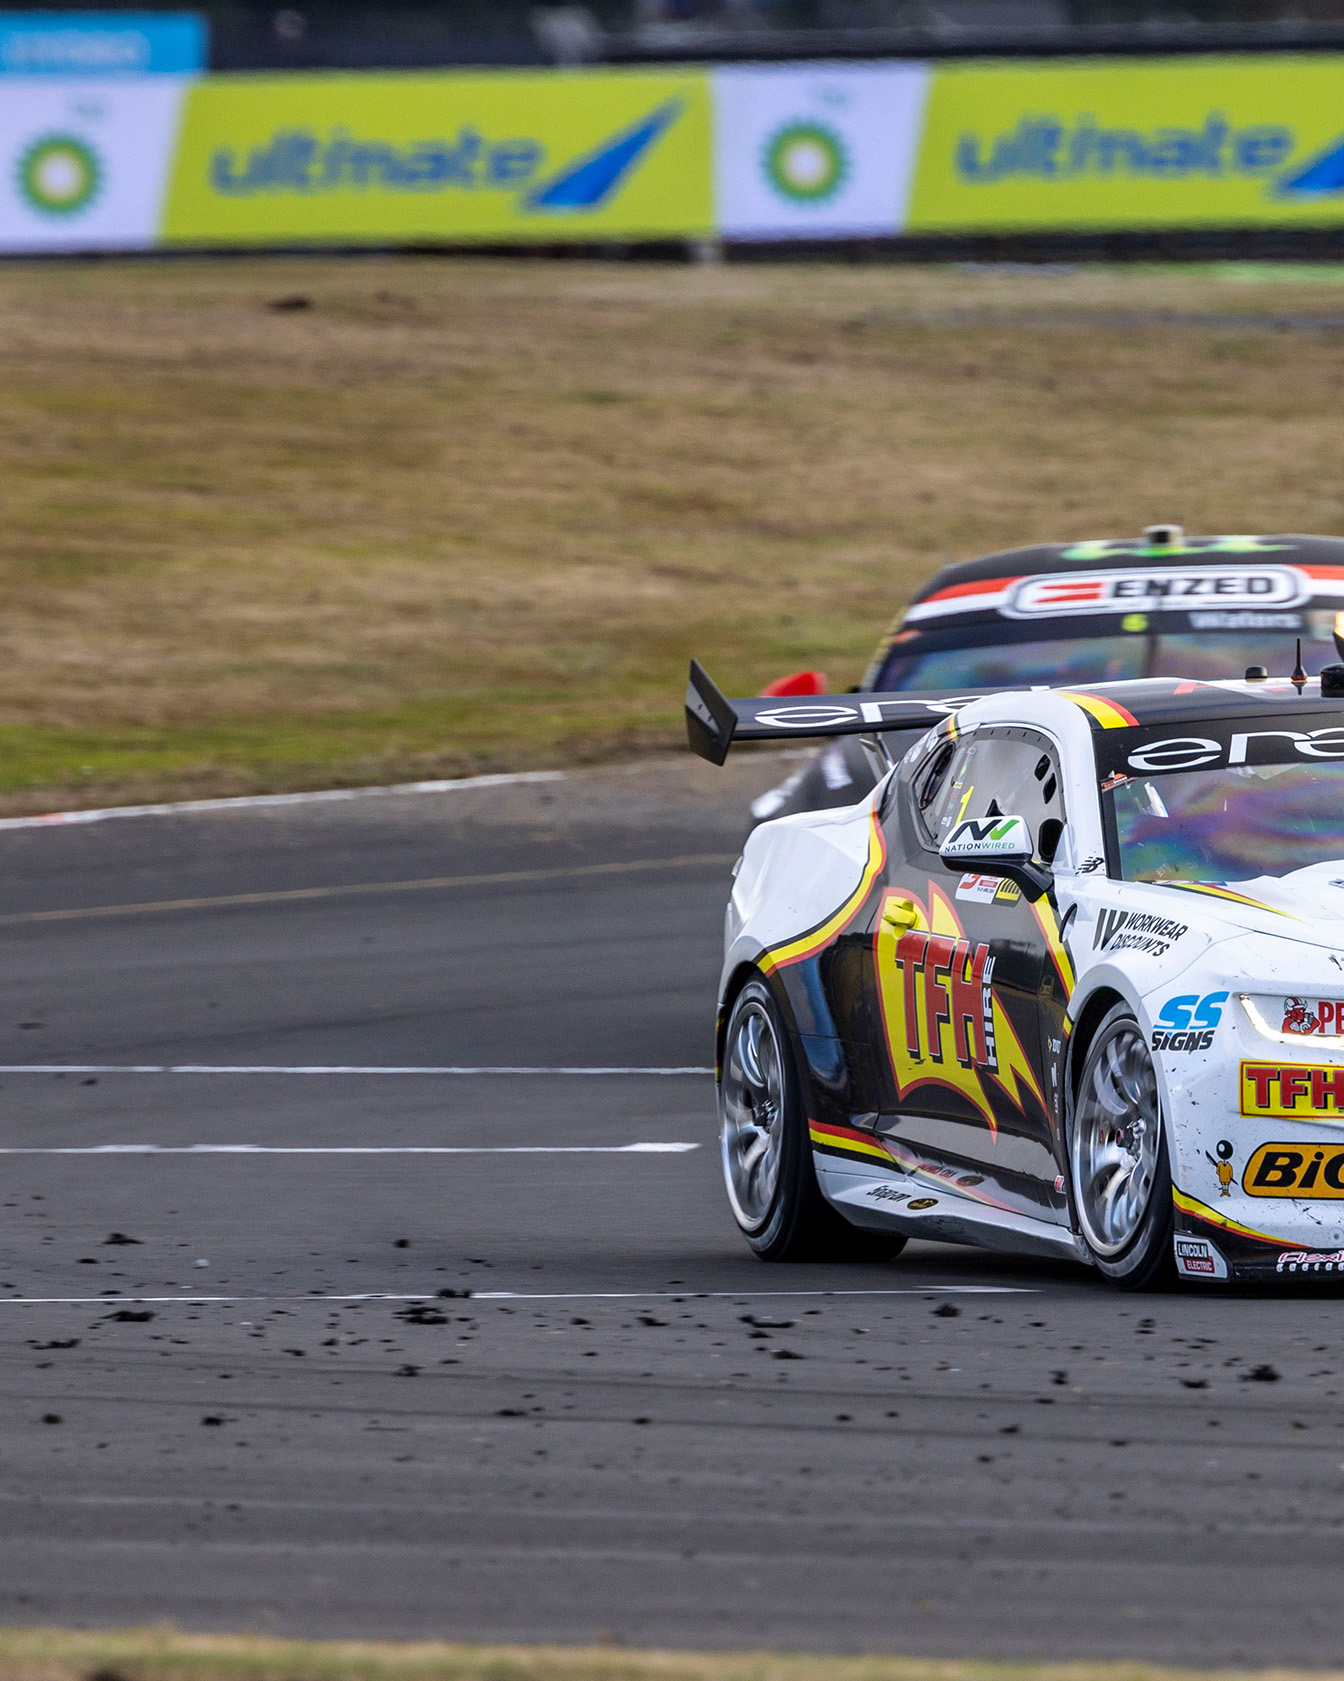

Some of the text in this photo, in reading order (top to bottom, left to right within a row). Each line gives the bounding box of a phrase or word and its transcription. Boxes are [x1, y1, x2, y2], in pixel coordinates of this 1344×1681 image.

[956, 112, 1291, 181] ultimate
[212, 125, 543, 191] ultimate
[1113, 577, 1273, 598] ENZED
[945, 842, 1015, 853] NATIONWIRED
[1124, 912, 1188, 941] WORKWEAR
[1110, 934, 1170, 956] DISCOUNTS
[895, 929, 998, 1067] TFH HIRE
[1153, 991, 1230, 1030] SS
[1152, 1030, 1215, 1051] SIGNS
[1178, 1243, 1207, 1257] LINCOLN
[1186, 1260, 1212, 1271] ELECTRIC
